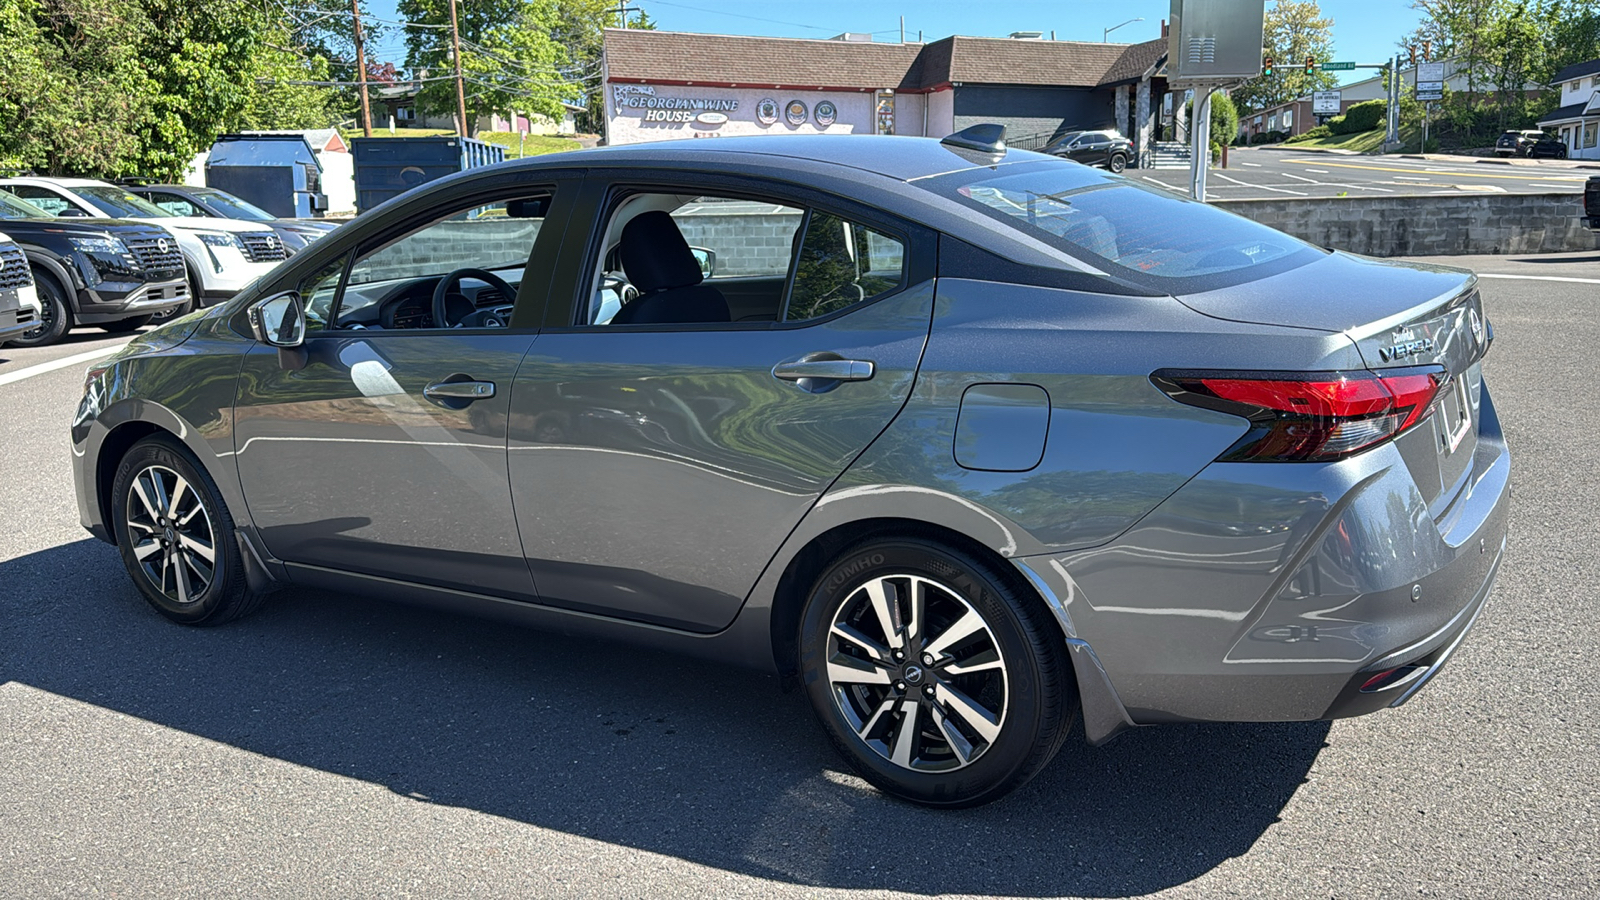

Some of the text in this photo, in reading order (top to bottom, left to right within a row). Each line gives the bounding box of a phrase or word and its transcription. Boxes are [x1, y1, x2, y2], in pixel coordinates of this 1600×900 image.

[628, 97, 739, 111] GEORGIAN WINE
[645, 110, 691, 122] HOUSE
[1379, 338, 1433, 363] VERSA
[825, 553, 885, 594] KUMHO
